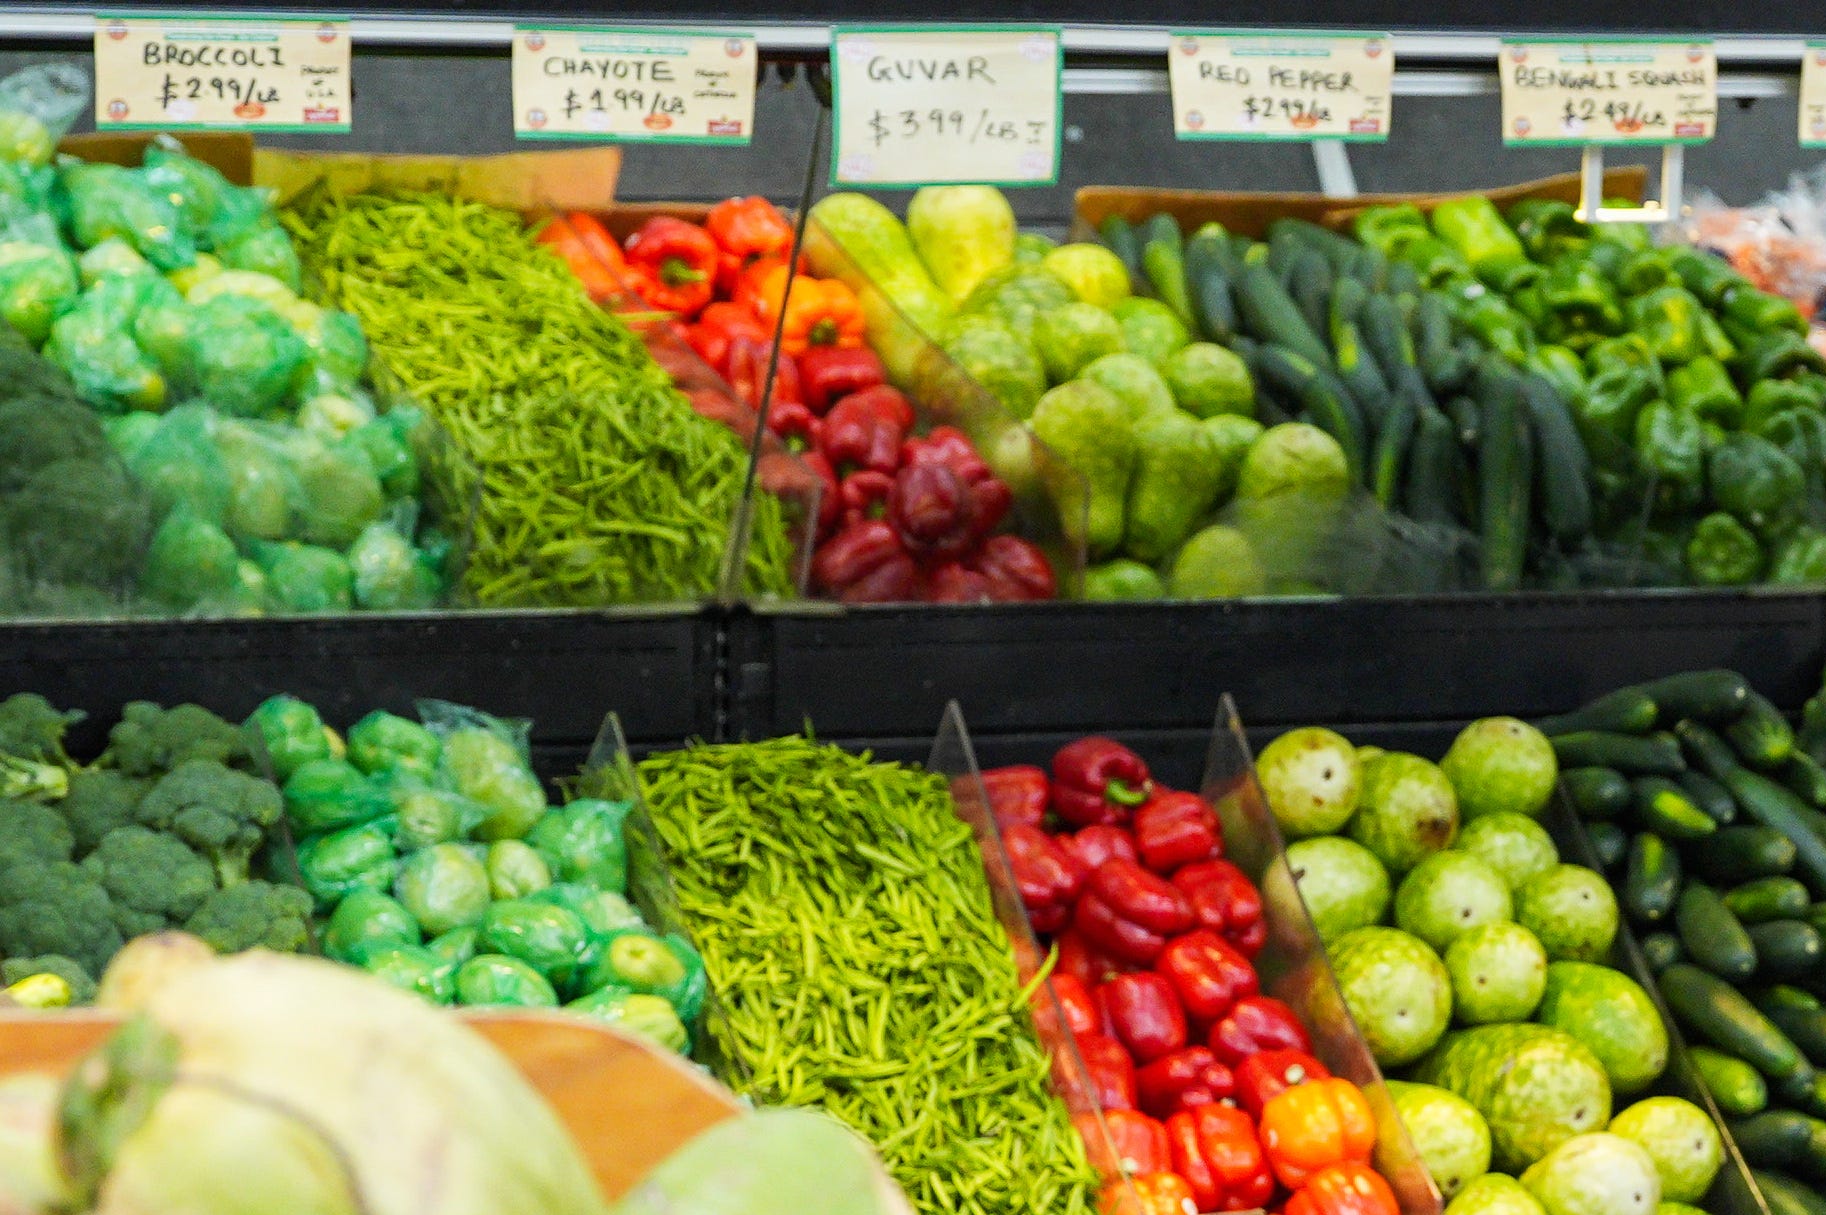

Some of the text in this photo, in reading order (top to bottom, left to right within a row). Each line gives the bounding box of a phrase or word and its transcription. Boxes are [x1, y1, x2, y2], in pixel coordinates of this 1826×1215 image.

[144, 43, 285, 66] BROCCOLI
[544, 56, 676, 83] CHAYOTE
[867, 56, 997, 84] GUVAR
[1200, 61, 1359, 92] RED PEPPER
[1627, 69, 1706, 87] SQUASH
